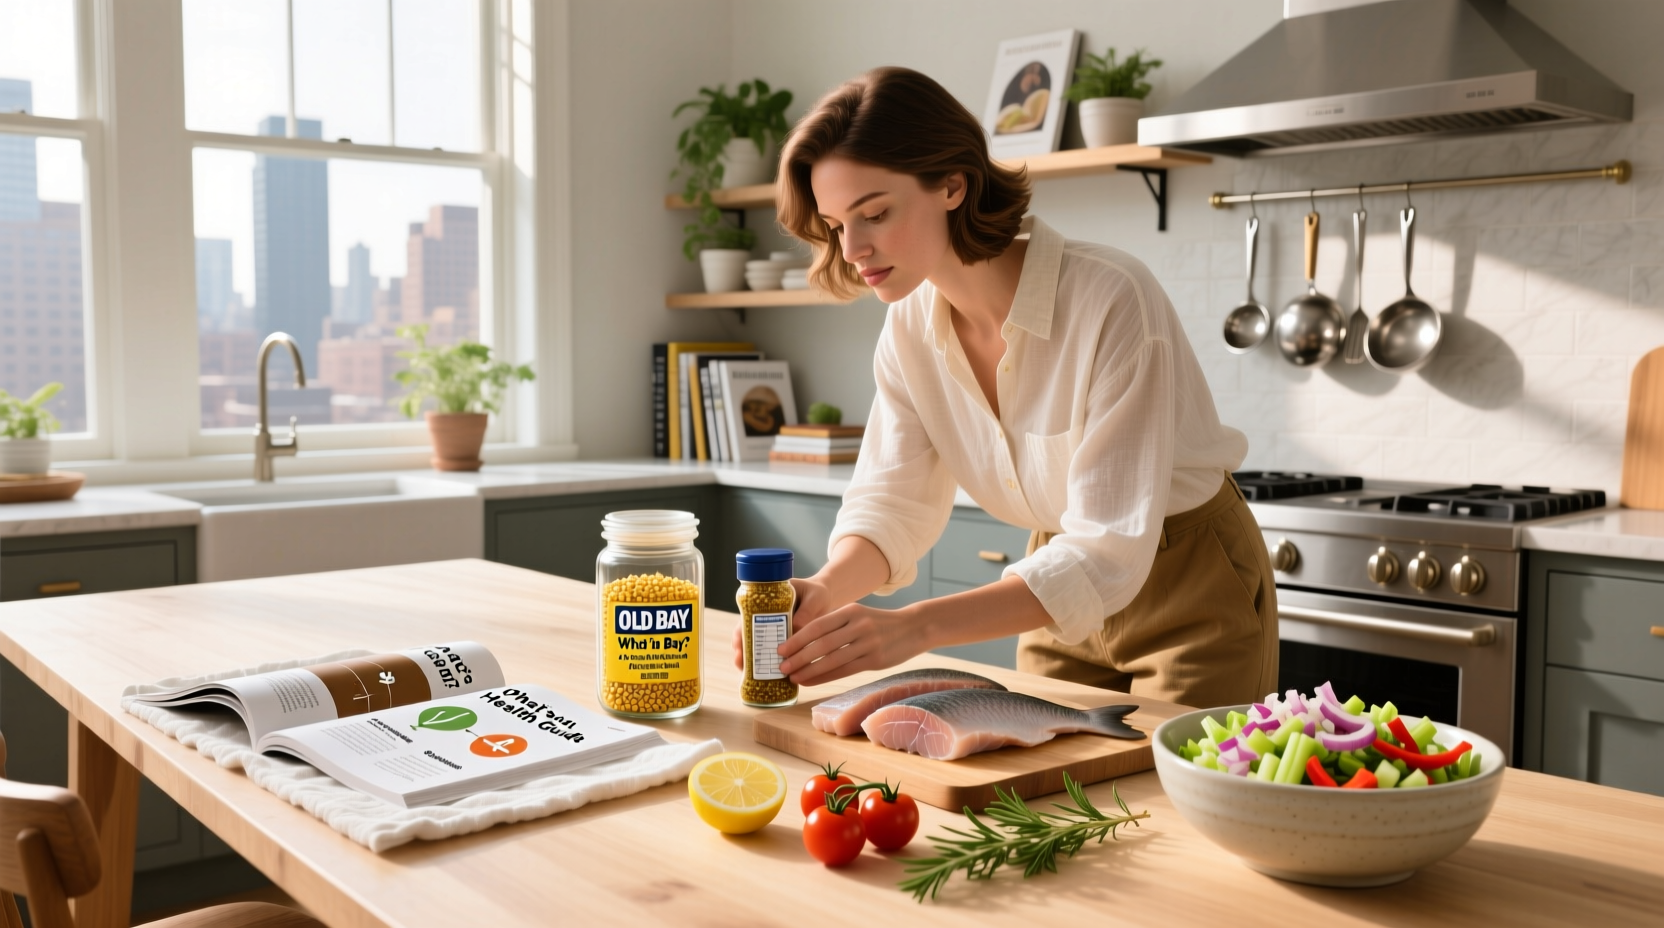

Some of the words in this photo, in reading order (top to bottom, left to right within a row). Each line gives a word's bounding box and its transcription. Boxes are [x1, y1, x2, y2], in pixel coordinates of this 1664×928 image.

[618, 609, 653, 631] OLD
[656, 608, 690, 630] BAY
[479, 691, 538, 724] Health
